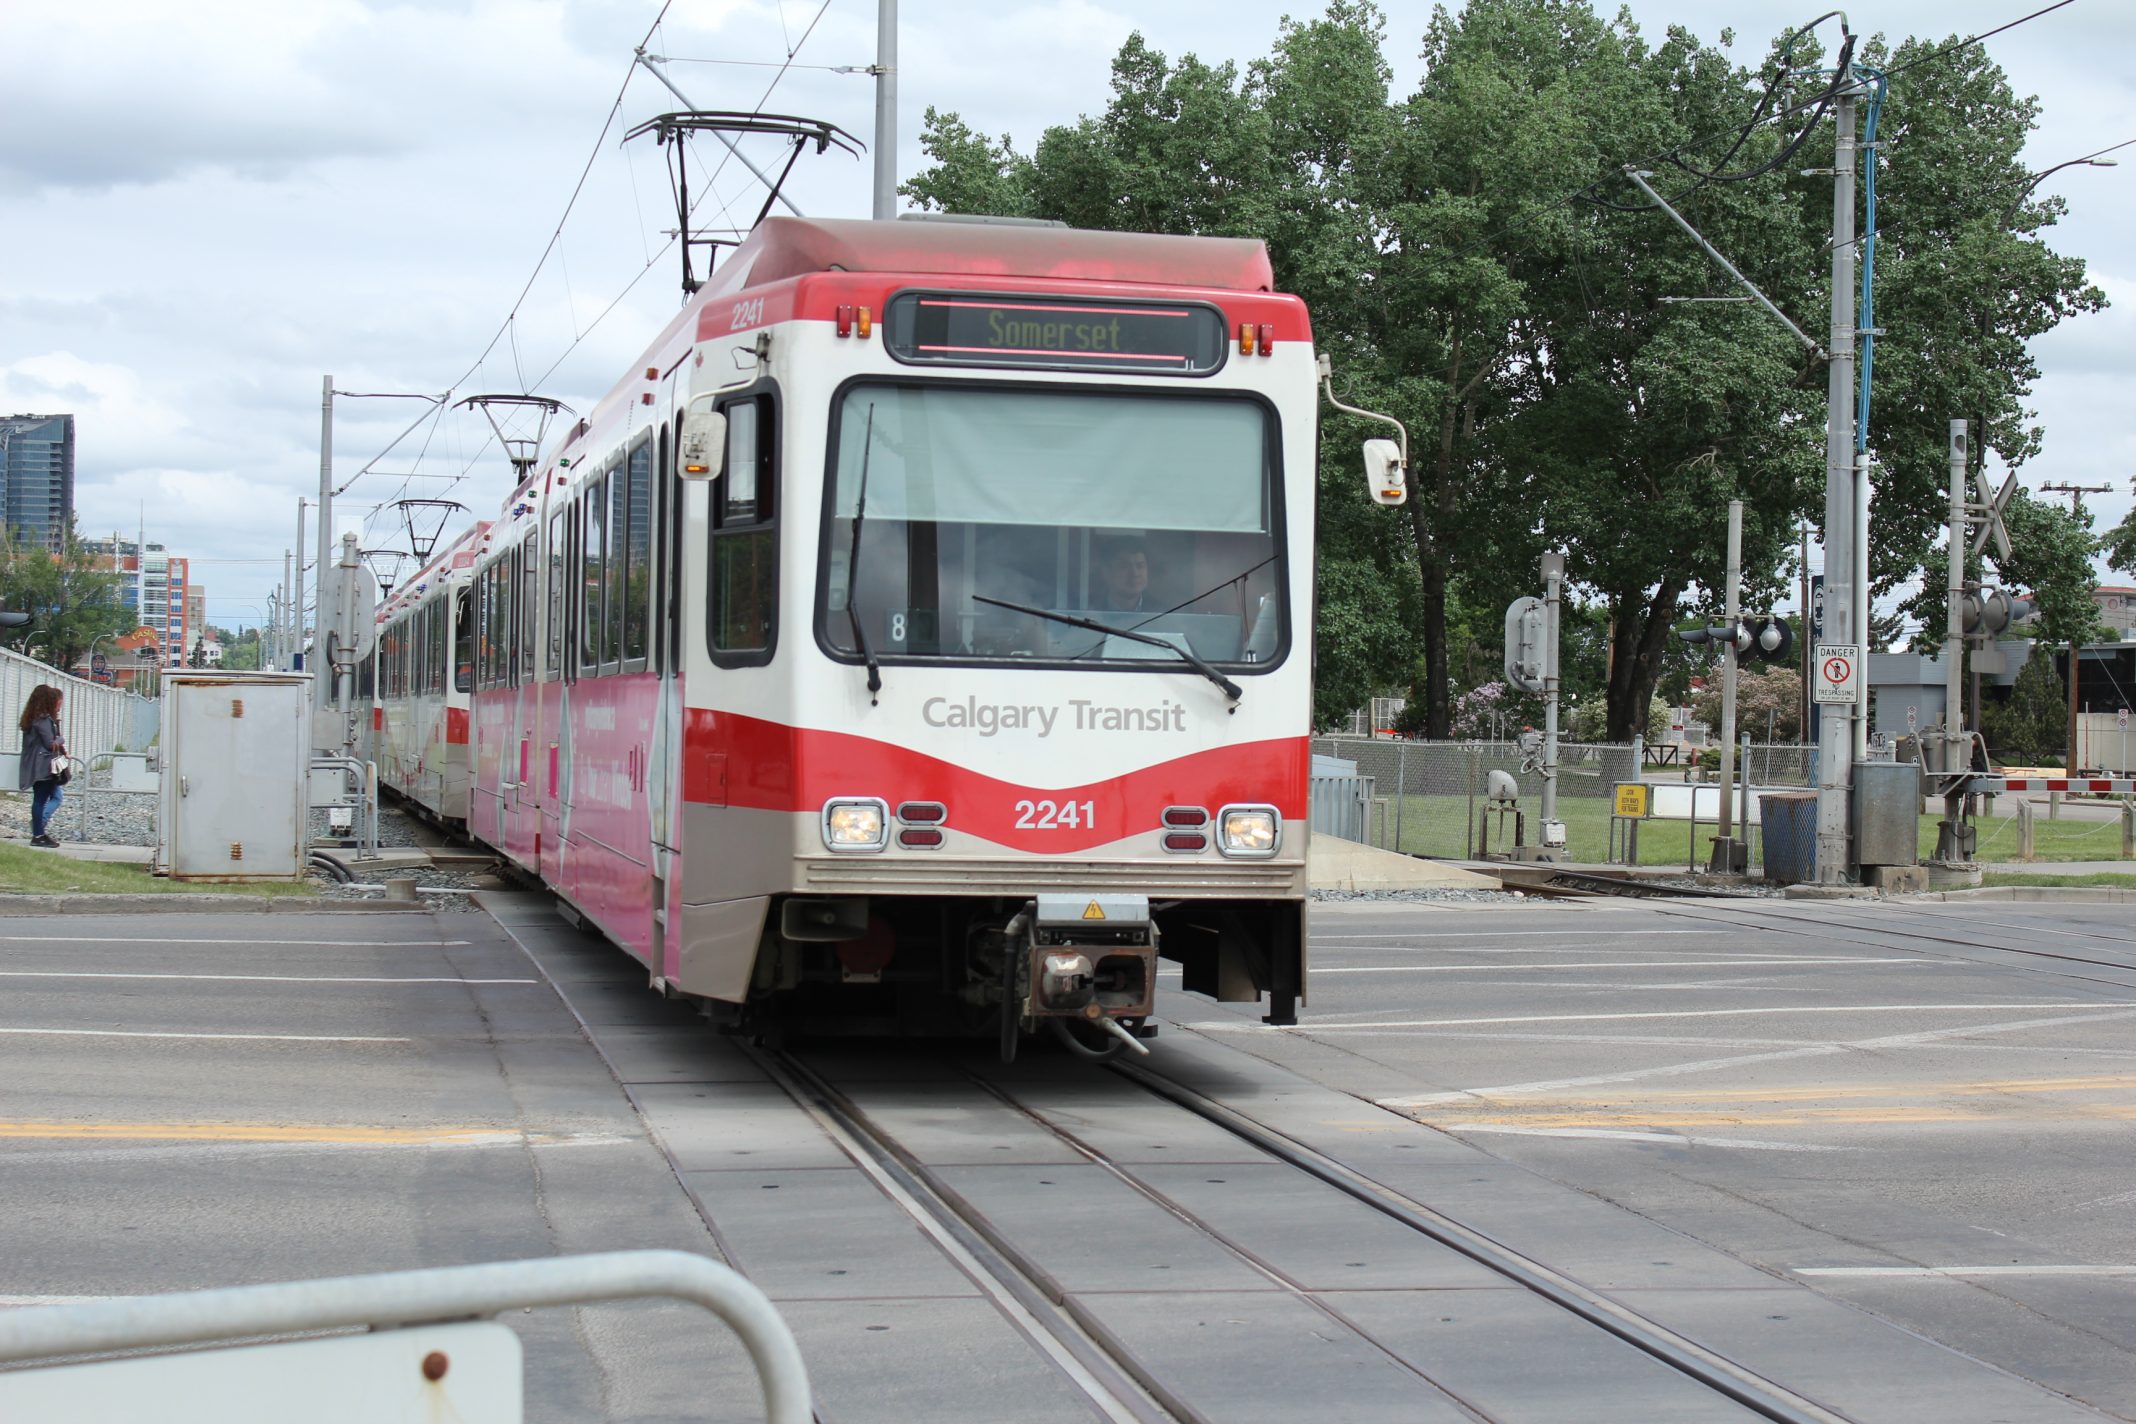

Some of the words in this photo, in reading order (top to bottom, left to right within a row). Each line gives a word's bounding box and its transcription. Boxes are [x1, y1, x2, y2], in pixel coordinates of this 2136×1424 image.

[730, 297, 765, 331] 2241
[987, 310, 1121, 351] Somerset
[892, 613, 906, 642] 8
[1820, 648, 1855, 658] DANGER
[1818, 689, 1854, 697] TRESPASSING
[922, 695, 1059, 738] Calgary
[1068, 699, 1187, 732] Transit
[1014, 800, 1094, 829] 2241
